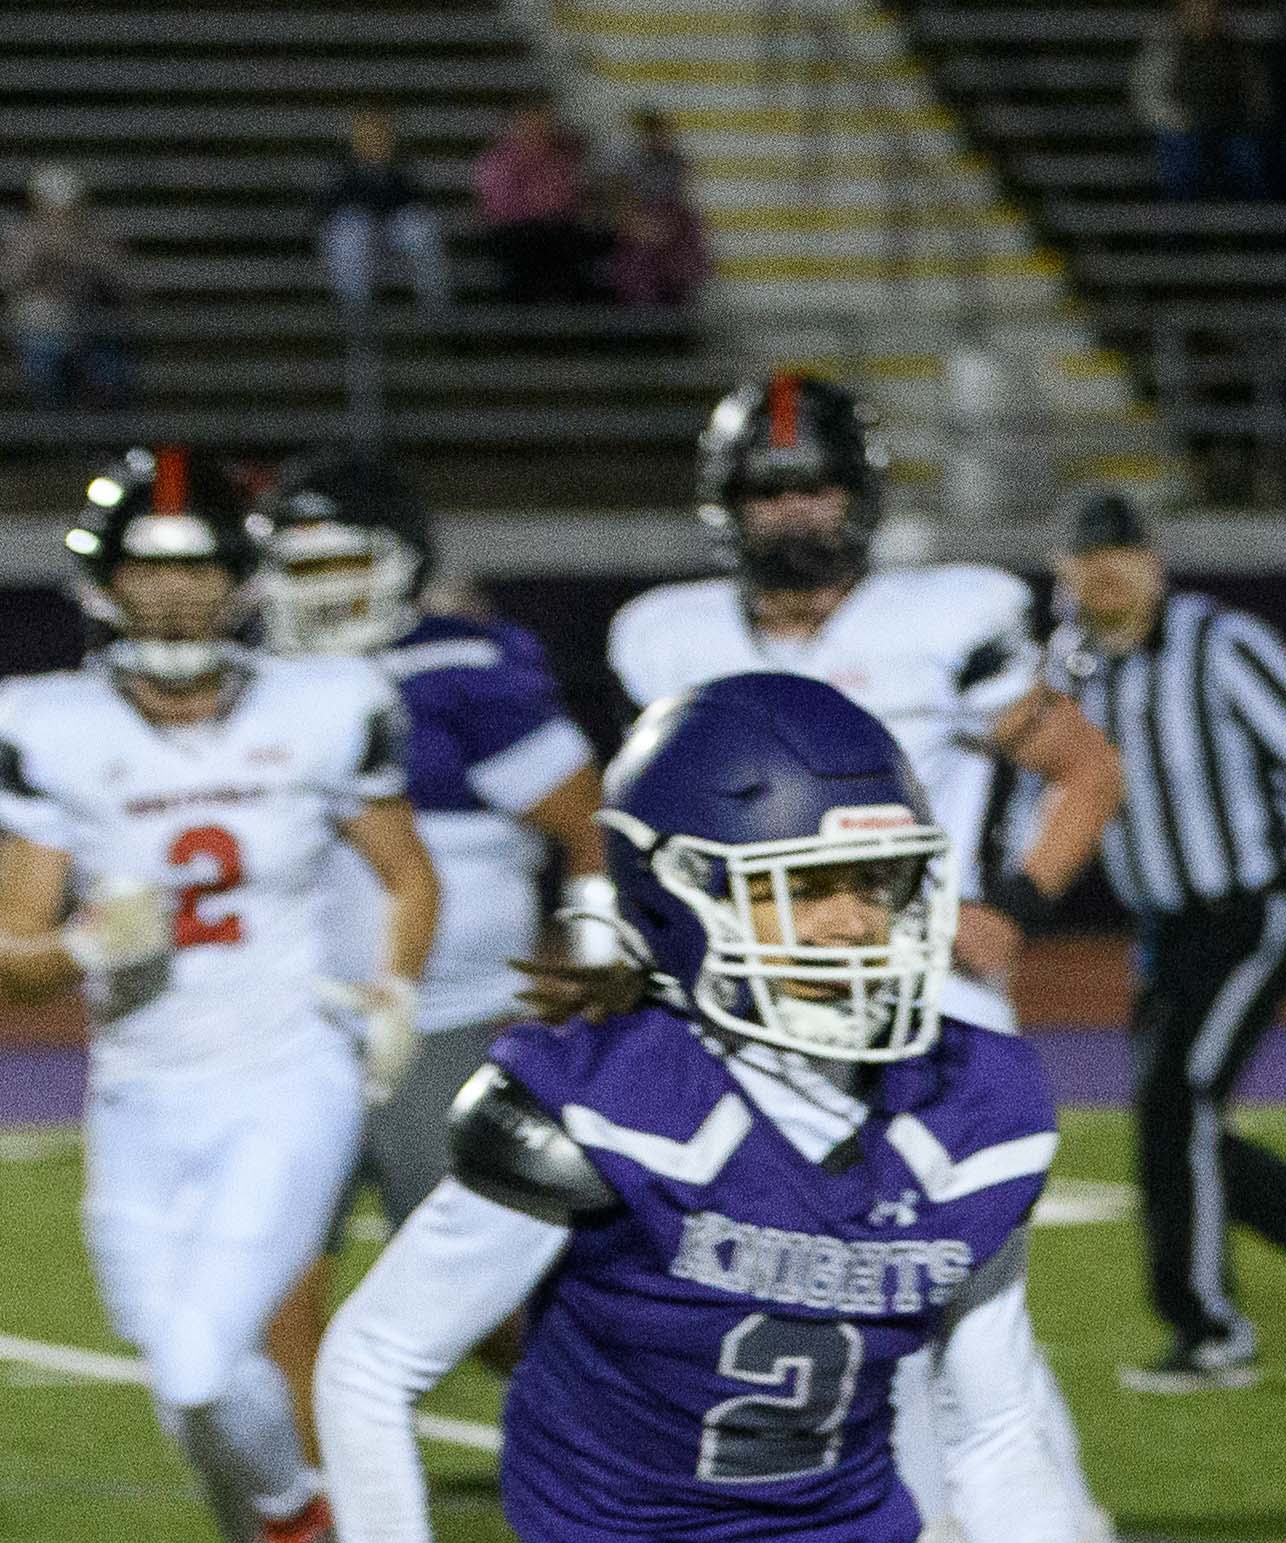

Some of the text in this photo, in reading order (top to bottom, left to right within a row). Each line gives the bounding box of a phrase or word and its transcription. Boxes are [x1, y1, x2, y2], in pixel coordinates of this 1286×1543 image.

[168, 824, 242, 948] 2
[669, 1210, 973, 1315] KNIGHTS
[695, 1312, 865, 1484] 2
